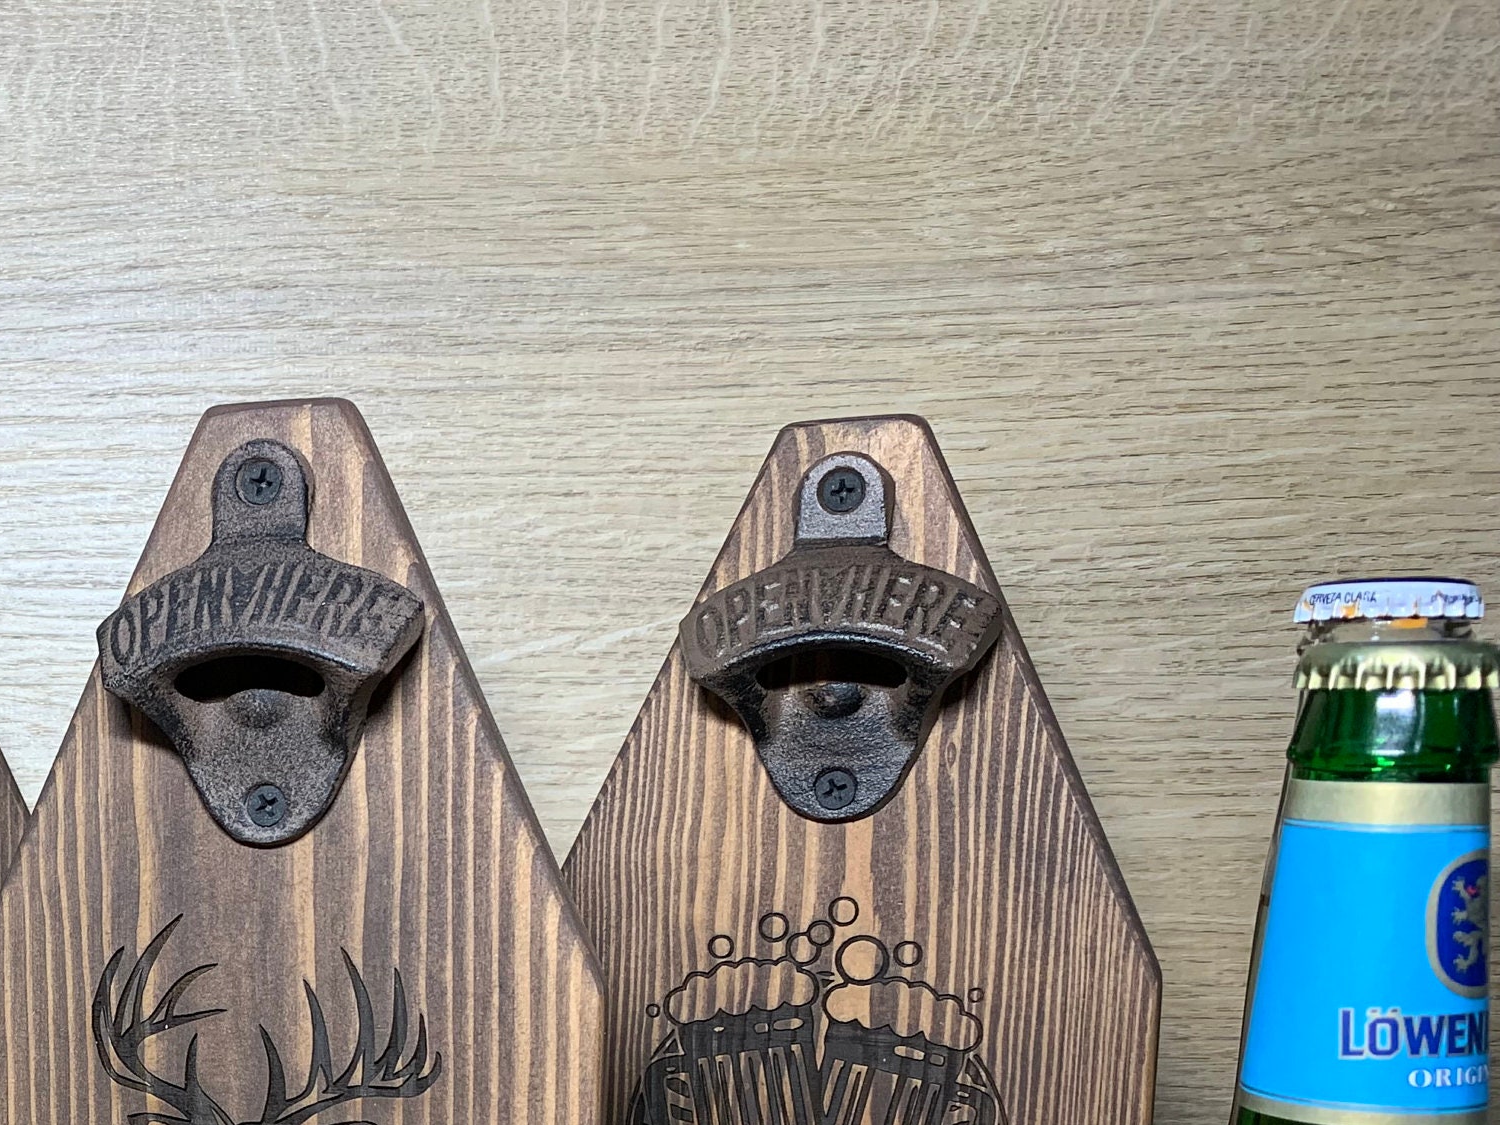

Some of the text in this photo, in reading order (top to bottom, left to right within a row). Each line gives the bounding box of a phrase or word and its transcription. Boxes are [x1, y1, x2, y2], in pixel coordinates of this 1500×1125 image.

[109, 563, 231, 667] OPEN
[695, 565, 817, 654] OPEN
[1338, 1005, 1489, 1060] LÖWEN
